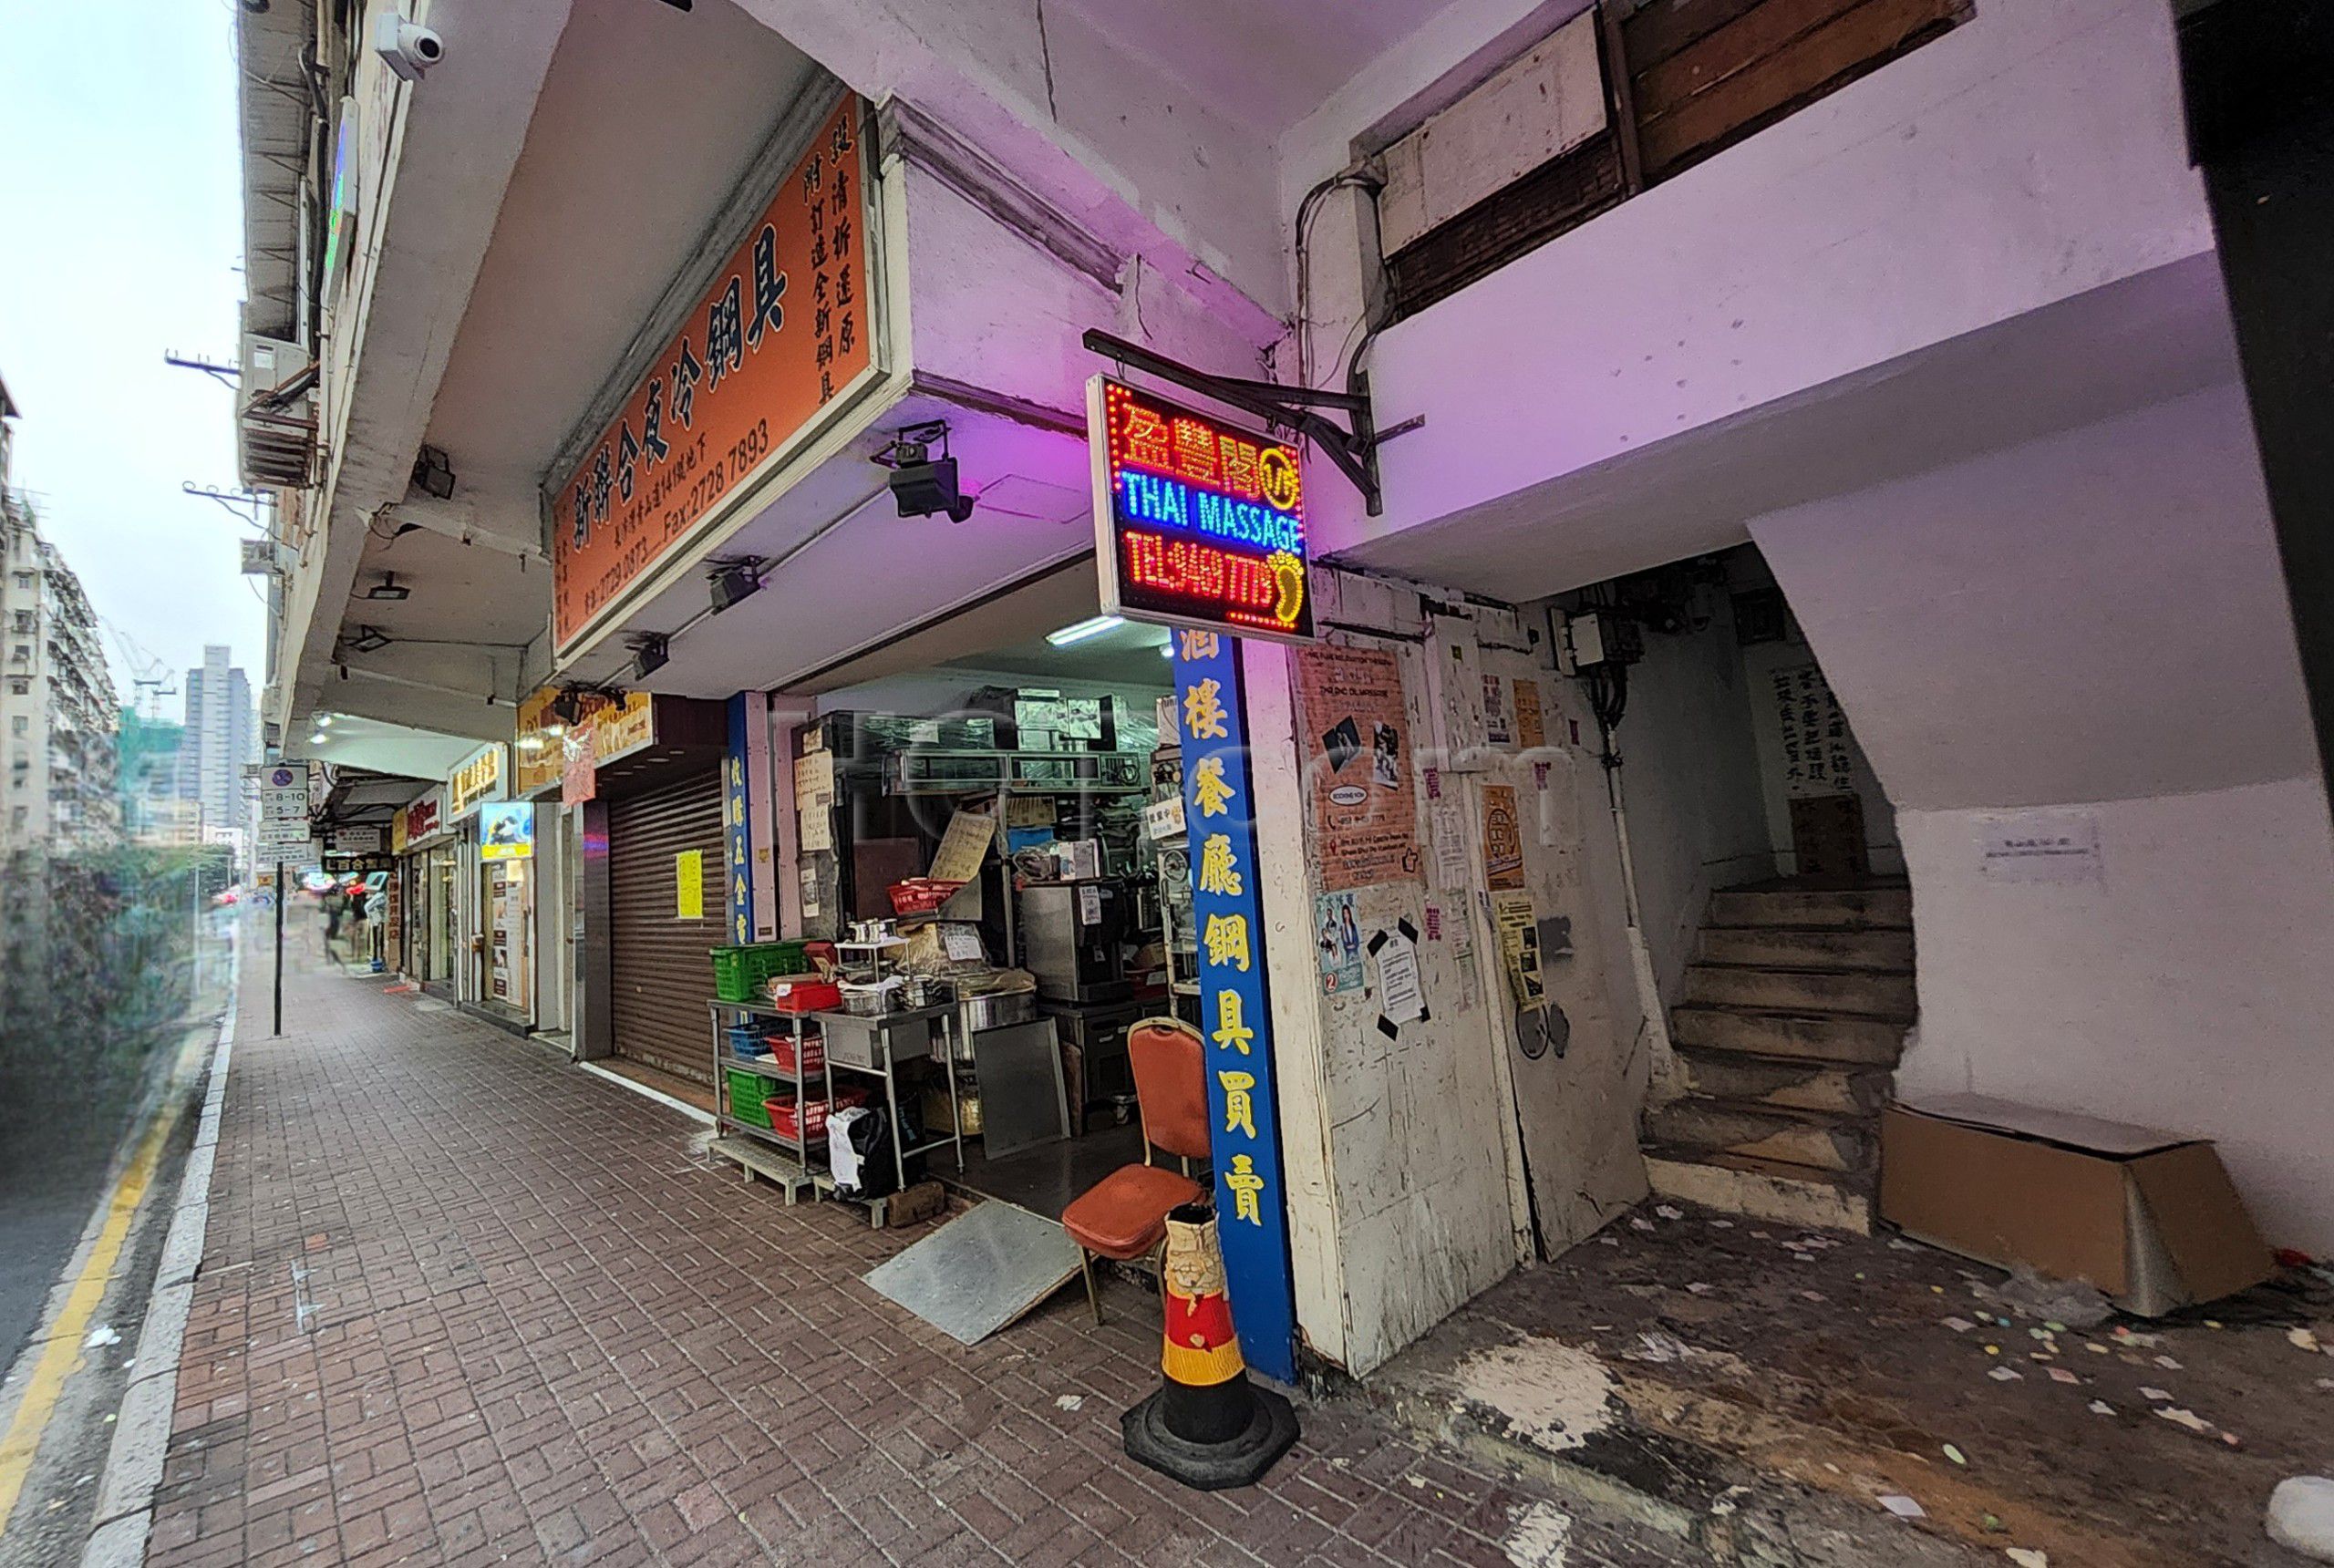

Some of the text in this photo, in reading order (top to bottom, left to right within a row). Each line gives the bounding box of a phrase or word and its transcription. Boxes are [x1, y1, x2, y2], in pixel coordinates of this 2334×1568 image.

[573, 223, 788, 554] 新聯合夜冷鋼具
[728, 418, 769, 481] 7893
[1121, 470, 1302, 553] THAI MASSAGE
[276, 793, 305, 801] 8-10
[276, 806, 300, 814] 5-7
[1179, 627, 1265, 1227] 酒樓餐廳鋼具買賣
